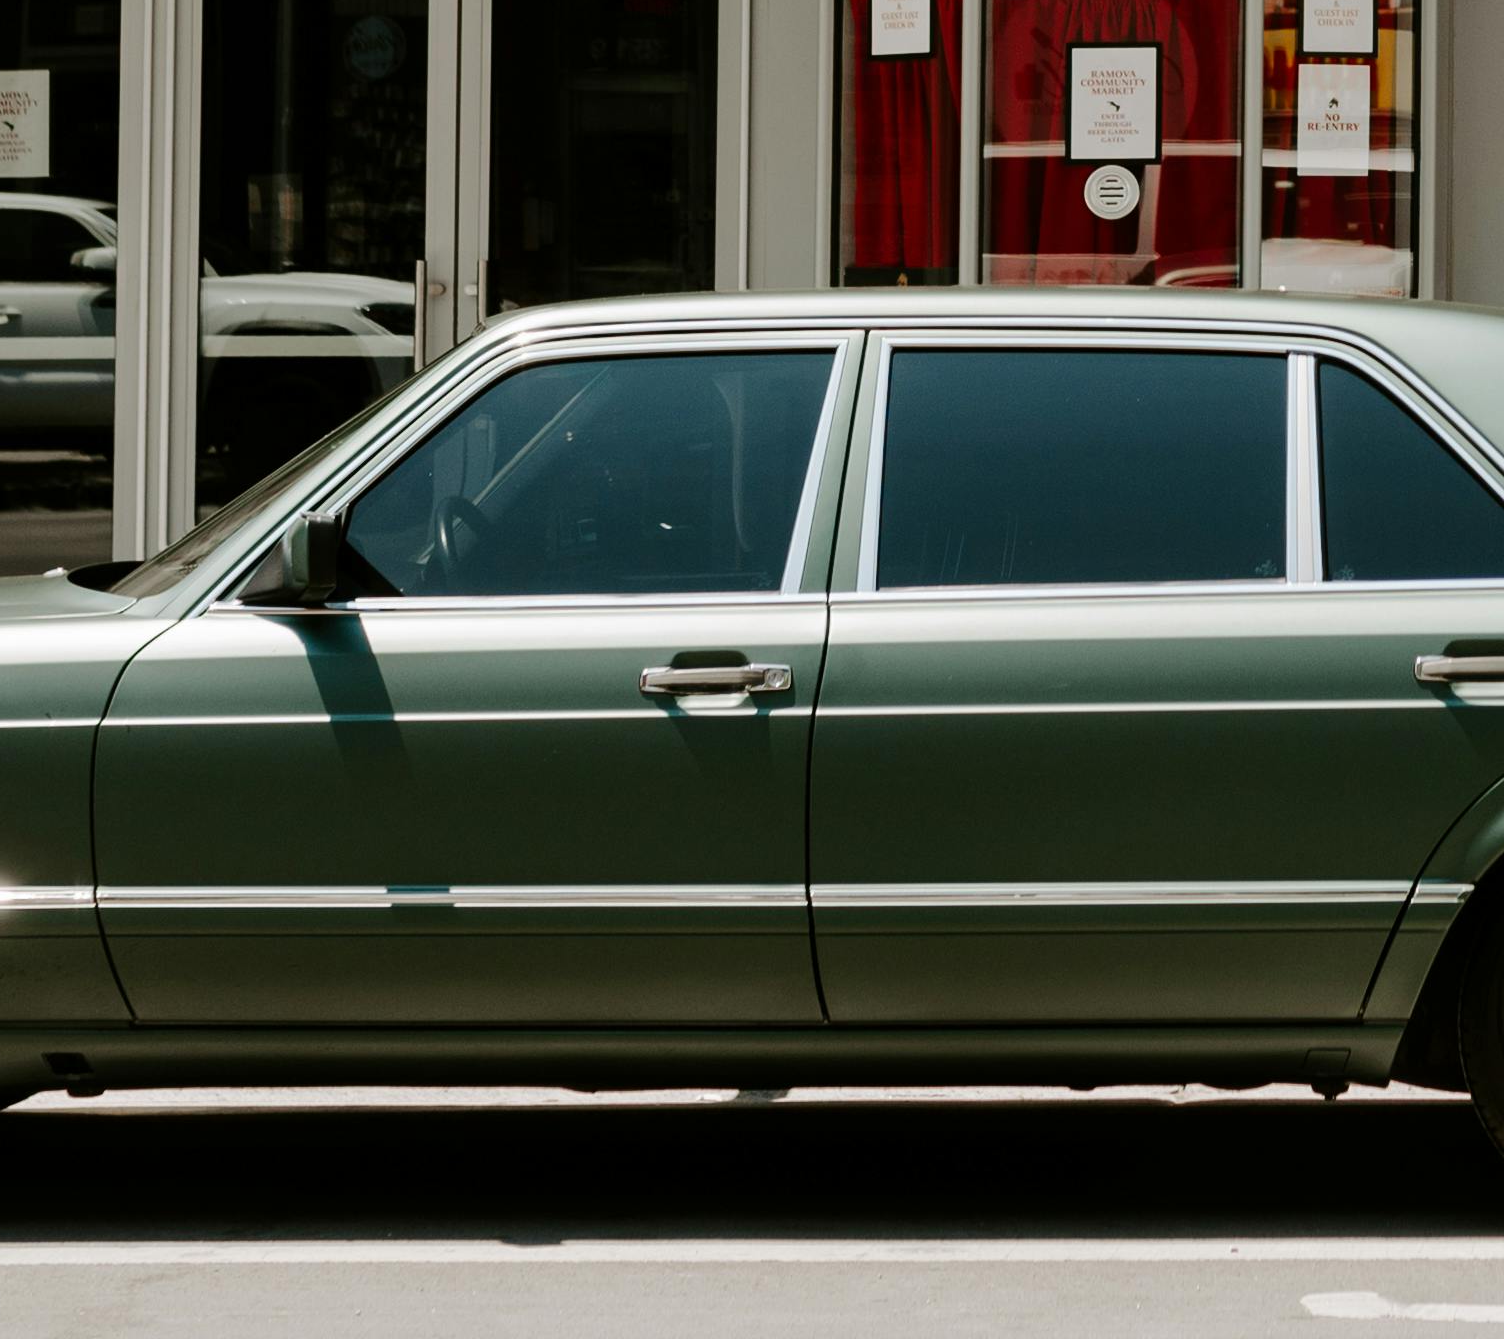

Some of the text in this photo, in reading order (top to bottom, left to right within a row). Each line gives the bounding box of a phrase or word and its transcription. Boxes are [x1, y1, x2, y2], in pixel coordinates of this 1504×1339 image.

[1090, 70, 1137, 78] RAMOVA
[1080, 78, 1146, 87] COMMUNITY
[1092, 87, 1135, 95] MARKET
[1325, 113, 1340, 122] NO
[1307, 122, 1360, 131] RE-ENTRY
